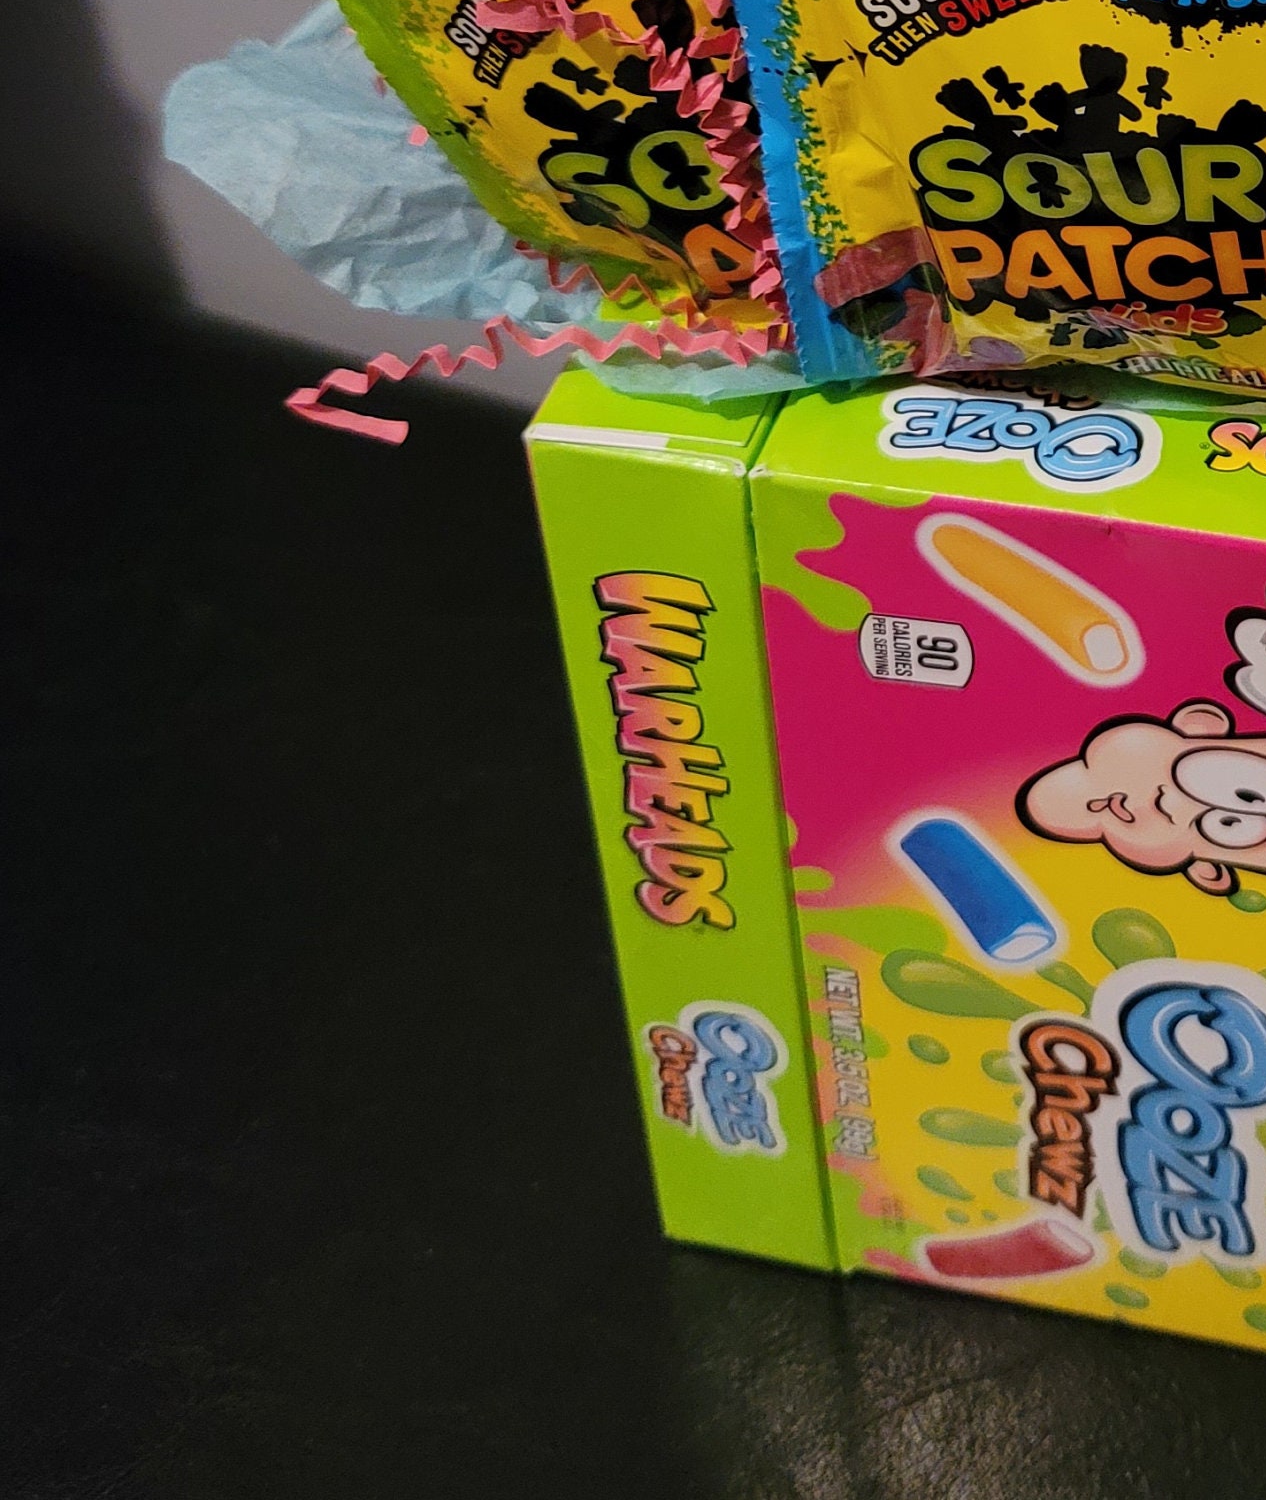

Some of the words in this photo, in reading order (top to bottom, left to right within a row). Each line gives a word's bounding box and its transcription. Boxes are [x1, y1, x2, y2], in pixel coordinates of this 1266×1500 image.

[871, 10, 939, 62] THEN
[917, 137, 1266, 225] SOUR
[892, 396, 1143, 482] OOZE
[872, 616, 887, 636] PER
[891, 620, 914, 678] CALORIES
[916, 634, 960, 672] 90
[873, 637, 890, 677] SERVING
[593, 569, 736, 930] WARHEADS
[824, 964, 862, 1007] NET
[648, 1024, 698, 1128] Chewz
[693, 1010, 780, 1150] OOZE
[834, 1078, 872, 1109] OZ
[1018, 1017, 1121, 1219] Chewz
